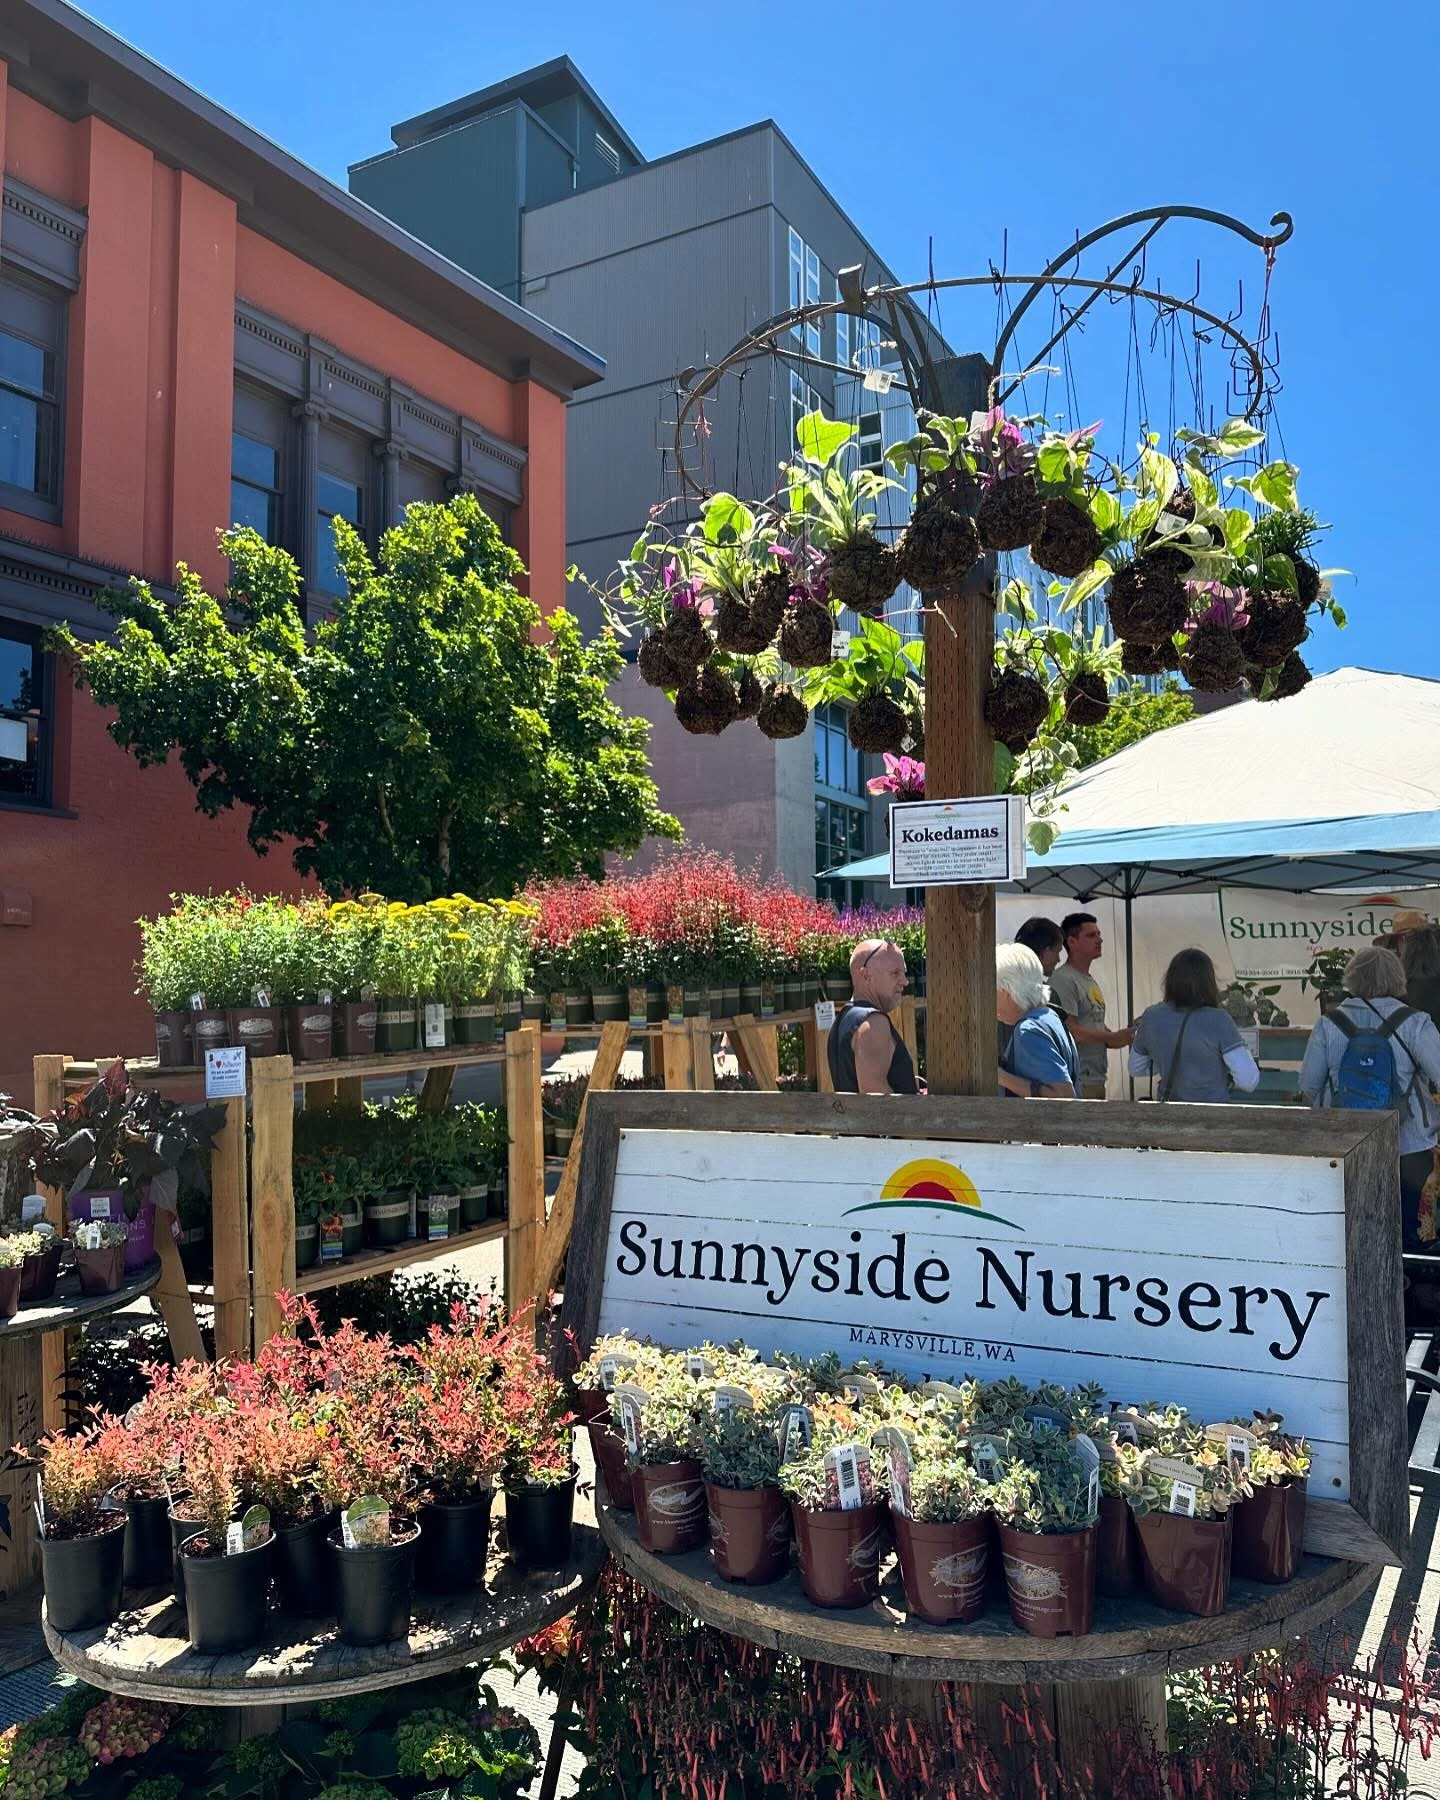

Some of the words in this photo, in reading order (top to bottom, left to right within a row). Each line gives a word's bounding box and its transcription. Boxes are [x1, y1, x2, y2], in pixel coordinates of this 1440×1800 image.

[901, 825, 999, 844] Kokedamas
[1229, 911, 1393, 945] Sunnyside
[616, 1220, 951, 1306] Sunnyside
[975, 1246, 1332, 1361] Nursery
